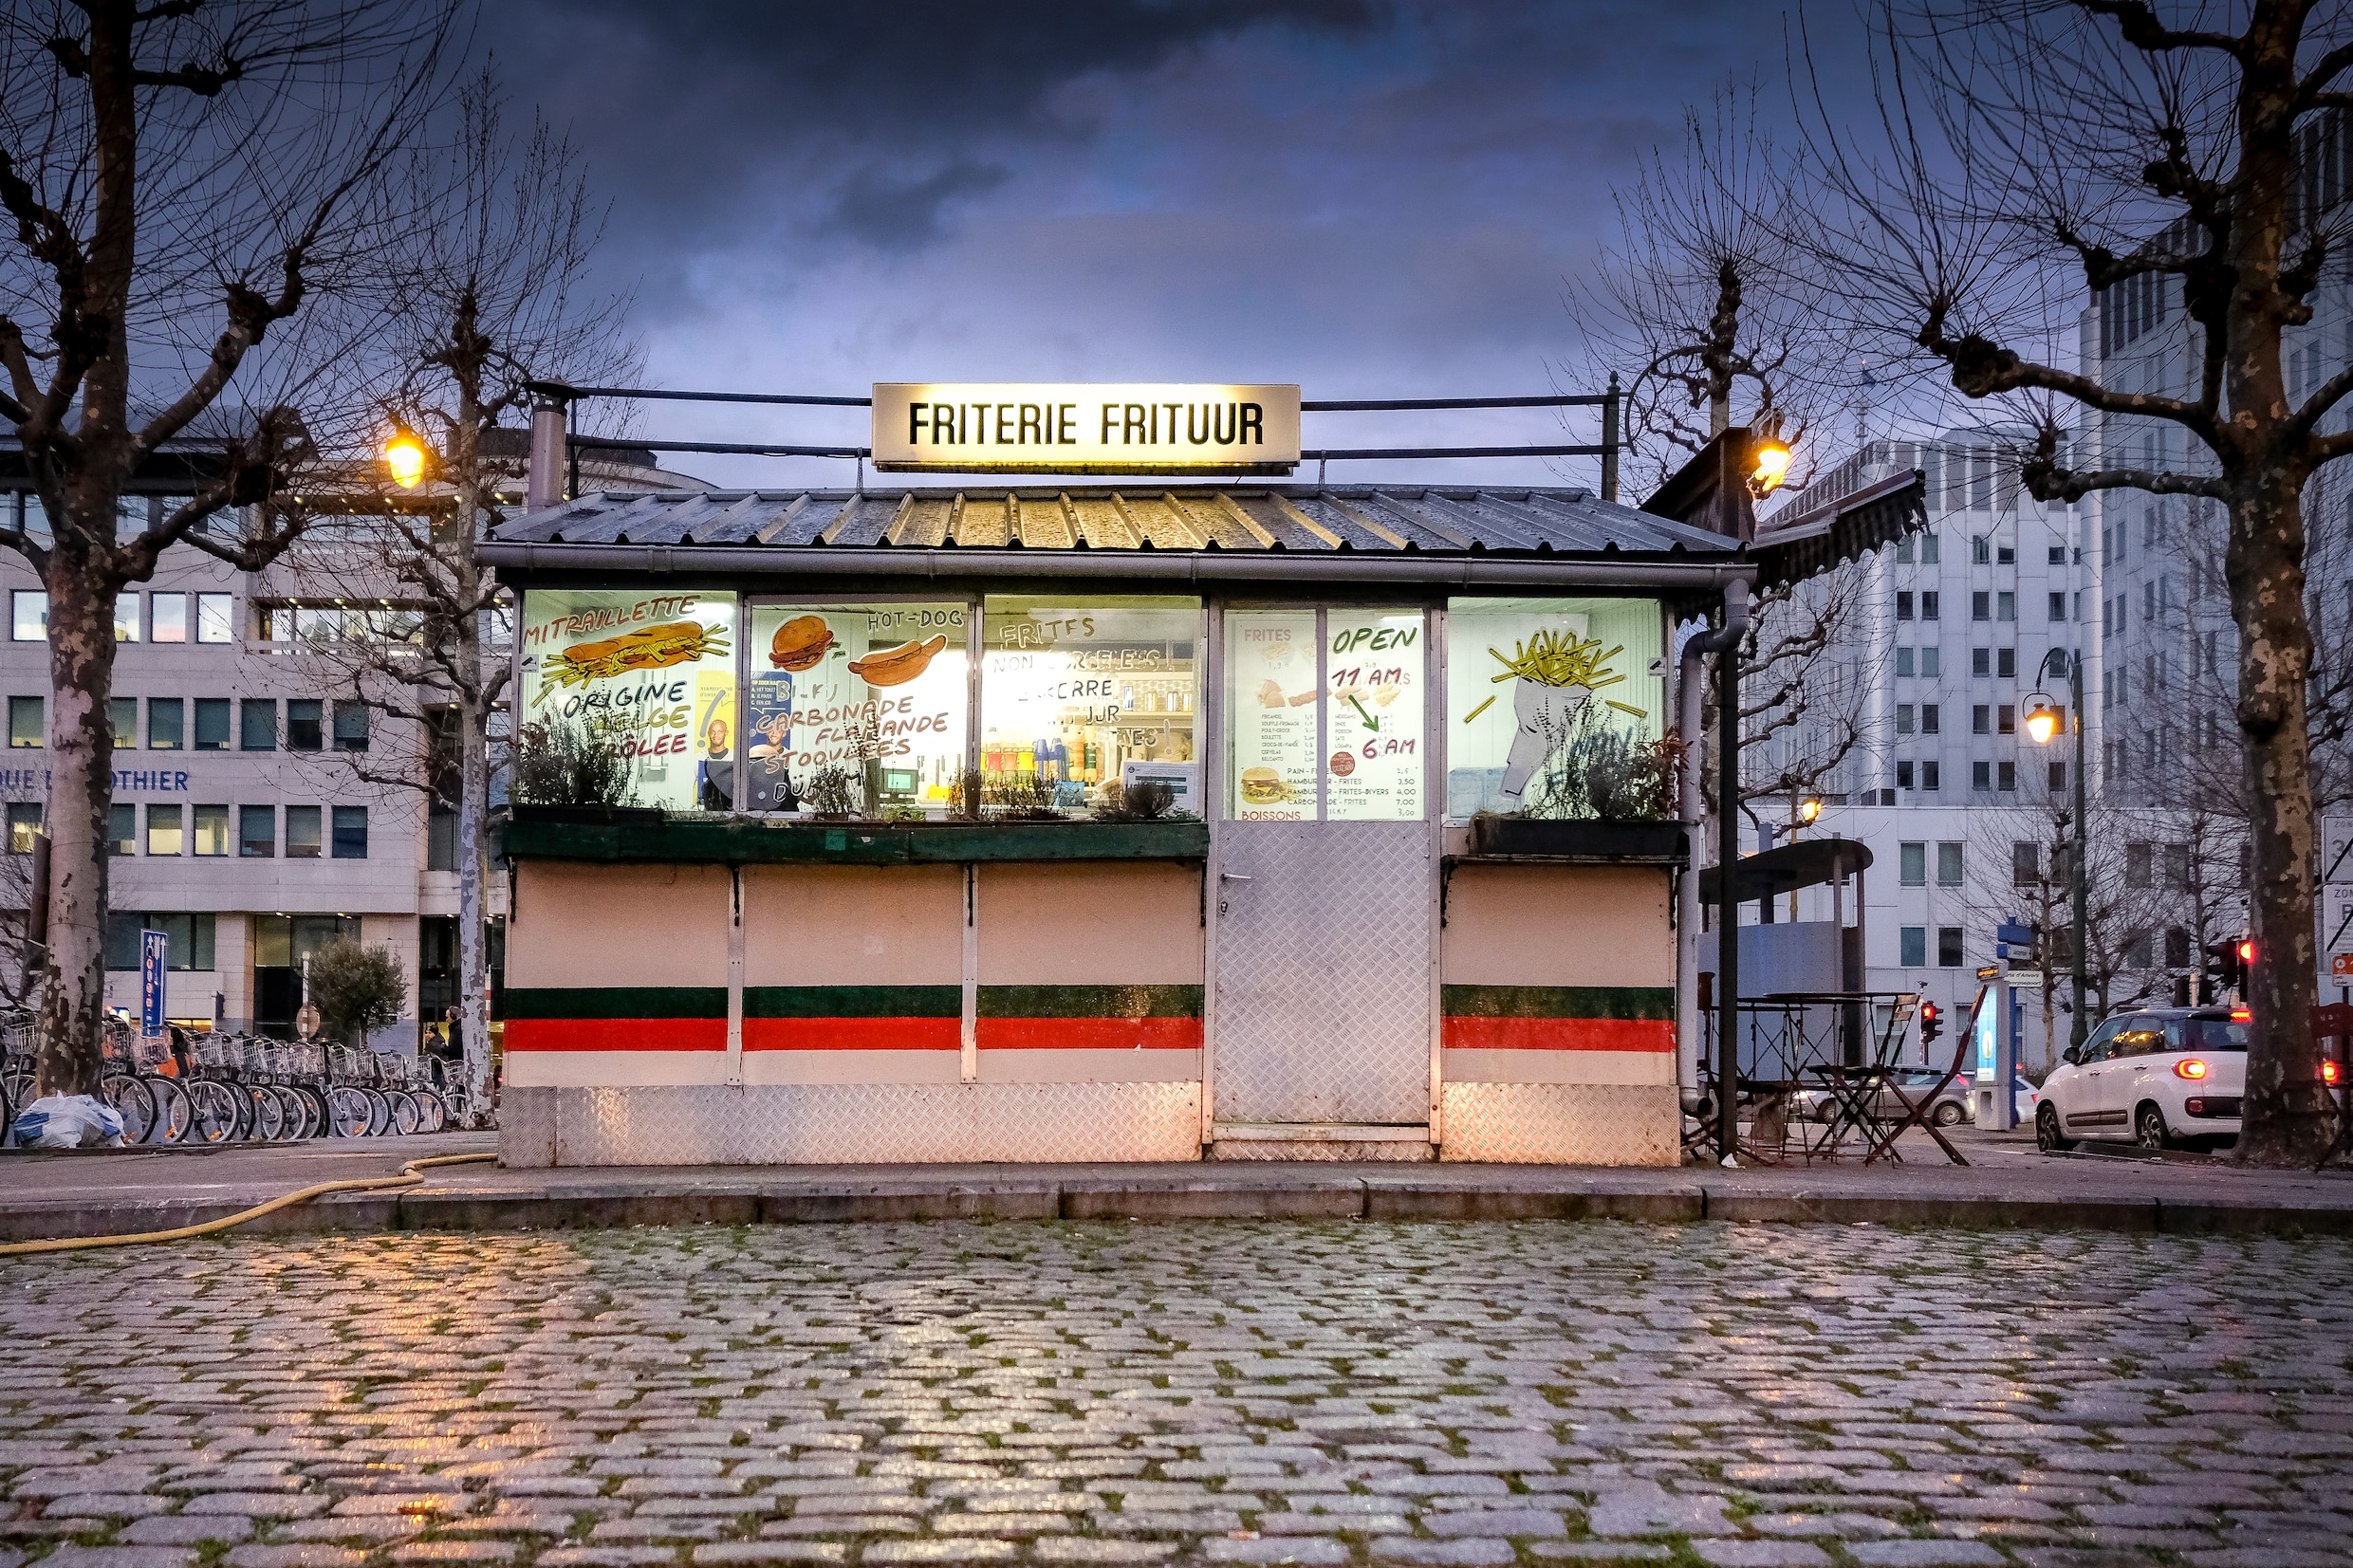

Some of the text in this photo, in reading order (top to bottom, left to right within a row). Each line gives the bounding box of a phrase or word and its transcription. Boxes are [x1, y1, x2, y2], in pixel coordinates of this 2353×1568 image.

[909, 402, 1264, 445] FRITERIE FRITUUR
[524, 595, 701, 646] MITRAILLETTE
[868, 610, 963, 632] HOT-DOG
[1244, 629, 1291, 641] FRITES
[1333, 626, 1417, 654] OPEN
[1331, 667, 1361, 687] 11
[1368, 667, 1401, 686] AM
[565, 681, 687, 718] ORIGINE
[756, 695, 914, 733] CARBONADE
[593, 705, 691, 739] BELGE
[815, 712, 949, 746] FLAMANDE
[1362, 738, 1416, 760] 6 AM
[1242, 811, 1301, 821] BOISSONS
